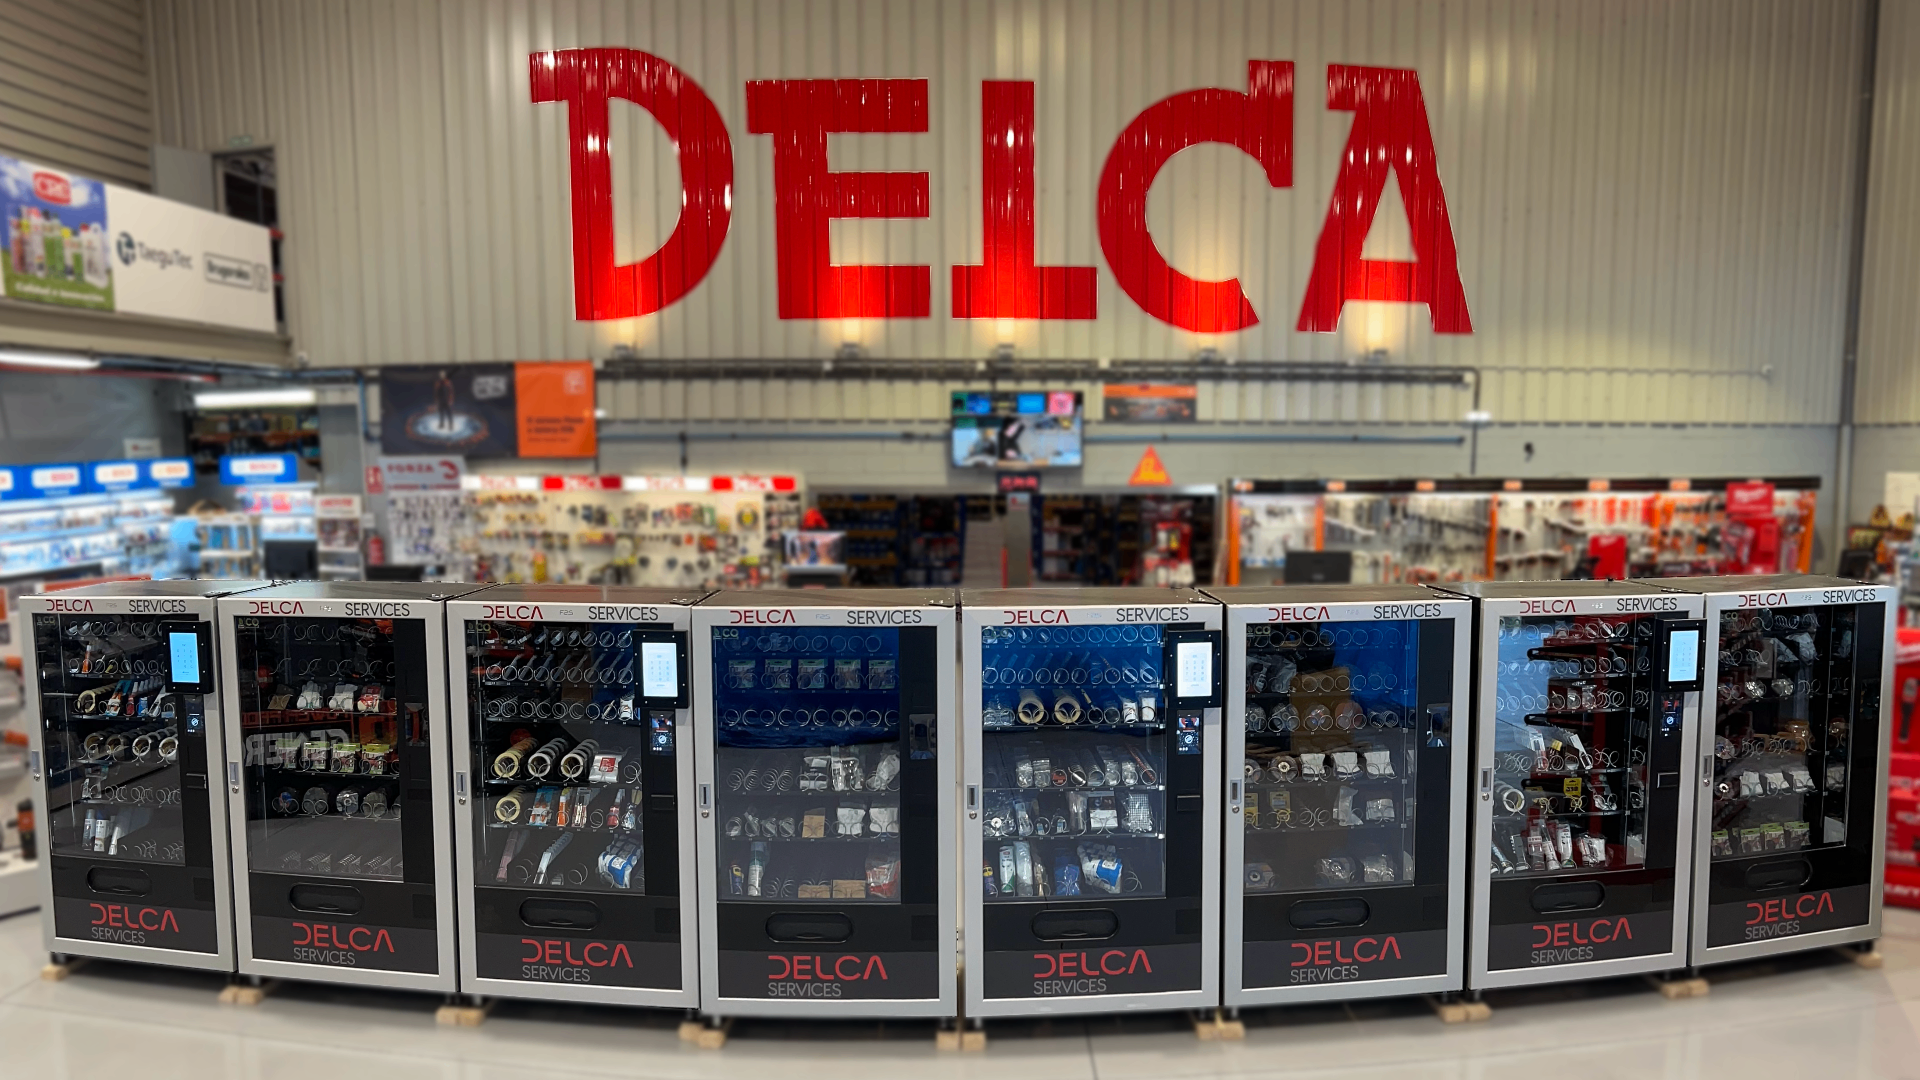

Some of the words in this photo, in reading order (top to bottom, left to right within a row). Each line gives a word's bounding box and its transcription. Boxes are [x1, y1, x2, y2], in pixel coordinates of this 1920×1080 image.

[528, 46, 1474, 334] DELCA
[46, 599, 93, 612] DELCA
[129, 600, 186, 613] SERVICES
[1519, 599, 1577, 614] DELCA
[1616, 597, 1678, 612] SERVICES
[1738, 592, 1788, 608] DELCA
[1822, 588, 1876, 604] SERVICES
[249, 601, 304, 615] DELCA
[345, 602, 410, 617] SERVICES
[483, 605, 543, 620] DELCA
[588, 606, 659, 621] SERVICES
[730, 609, 796, 624] DELCA
[846, 609, 922, 625] SERVICES
[1003, 609, 1070, 625] DELCA
[1116, 607, 1189, 622] SERVICES
[1268, 605, 1331, 622] DELCA
[1373, 604, 1442, 619] SERVICES
[1746, 892, 1834, 926] DELCA
[91, 904, 179, 933] DELCA
[91, 927, 145, 944] SERVICES
[294, 922, 395, 953] DELCA
[1532, 917, 1632, 949] DELCA
[1745, 920, 1799, 940] SERVICES
[294, 947, 355, 965] SERVICES
[522, 939, 633, 969] DELCA
[1291, 936, 1402, 967] DELCA
[1531, 946, 1593, 964] SERVICES
[768, 955, 888, 981] DELCA
[1034, 949, 1152, 979] DELCA
[522, 965, 590, 982] SERVICES
[1290, 965, 1358, 983] SERVICES
[768, 982, 841, 997] SERVICES
[1033, 978, 1107, 995] SERVICES
